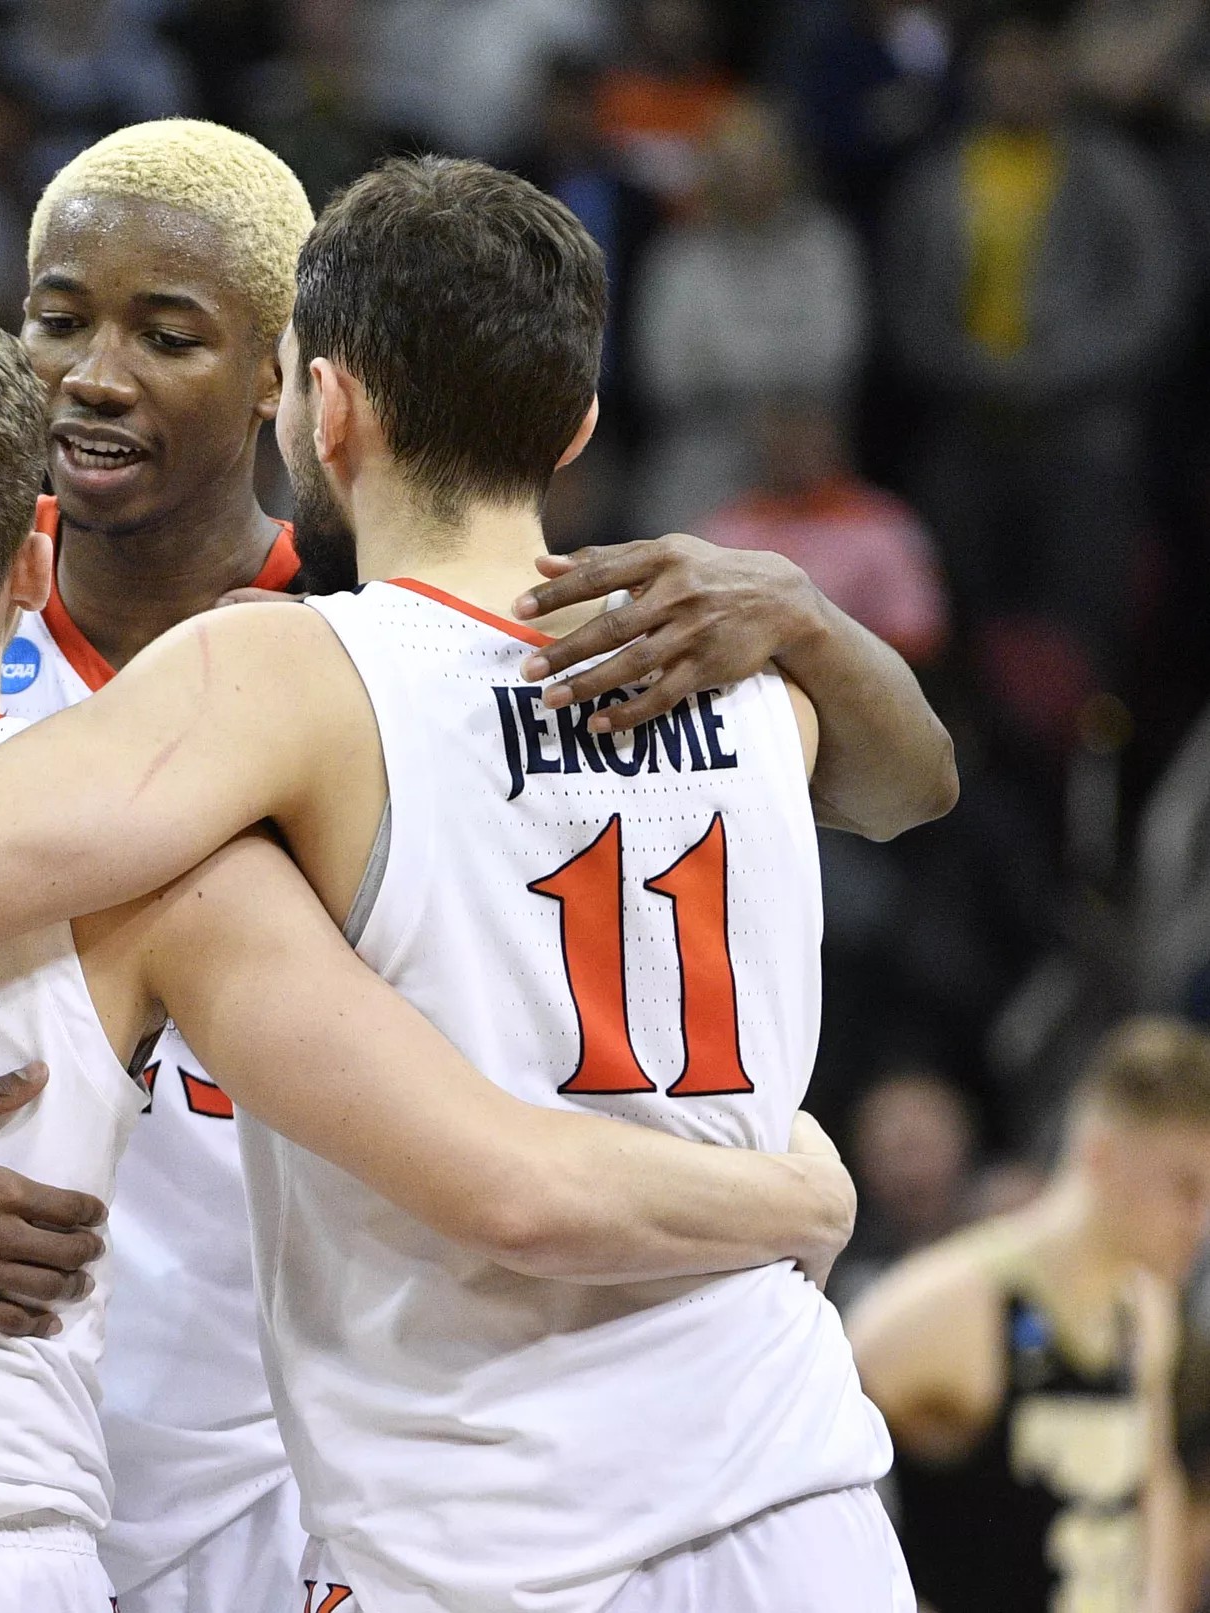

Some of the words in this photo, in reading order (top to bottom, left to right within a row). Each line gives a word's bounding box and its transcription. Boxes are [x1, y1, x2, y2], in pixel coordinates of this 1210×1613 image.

[1, 663, 36, 679] CAA
[491, 686, 738, 801] JEROME
[526, 811, 755, 1097] 11
